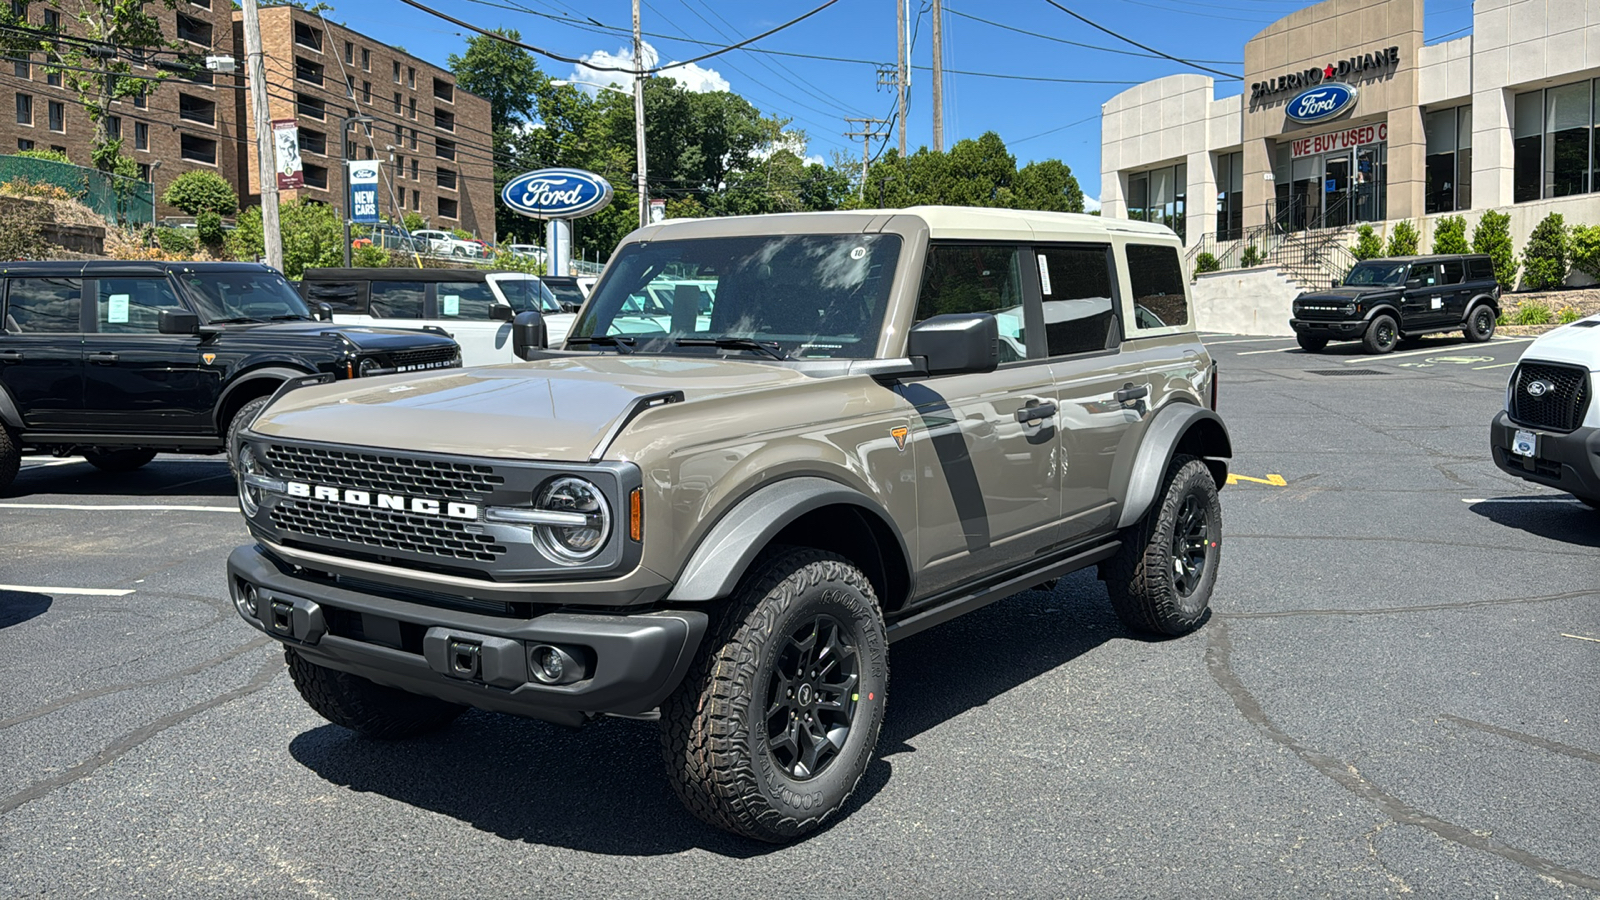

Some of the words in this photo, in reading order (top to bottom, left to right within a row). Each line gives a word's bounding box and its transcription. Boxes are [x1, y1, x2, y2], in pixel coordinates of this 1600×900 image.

[1251, 67, 1323, 98] SALERNO
[1338, 46, 1399, 77] DUANE
[1298, 91, 1337, 117] Ford
[1292, 138, 1311, 157] WE
[1314, 133, 1338, 152] BUY
[1341, 126, 1374, 147] USED
[354, 190, 375, 204] NEW
[522, 179, 583, 206] Ford
[354, 204, 376, 215] CARS
[397, 361, 450, 372] BRONCO
[287, 481, 478, 519] BRONCO
[821, 589, 882, 678] GOODYEAR
